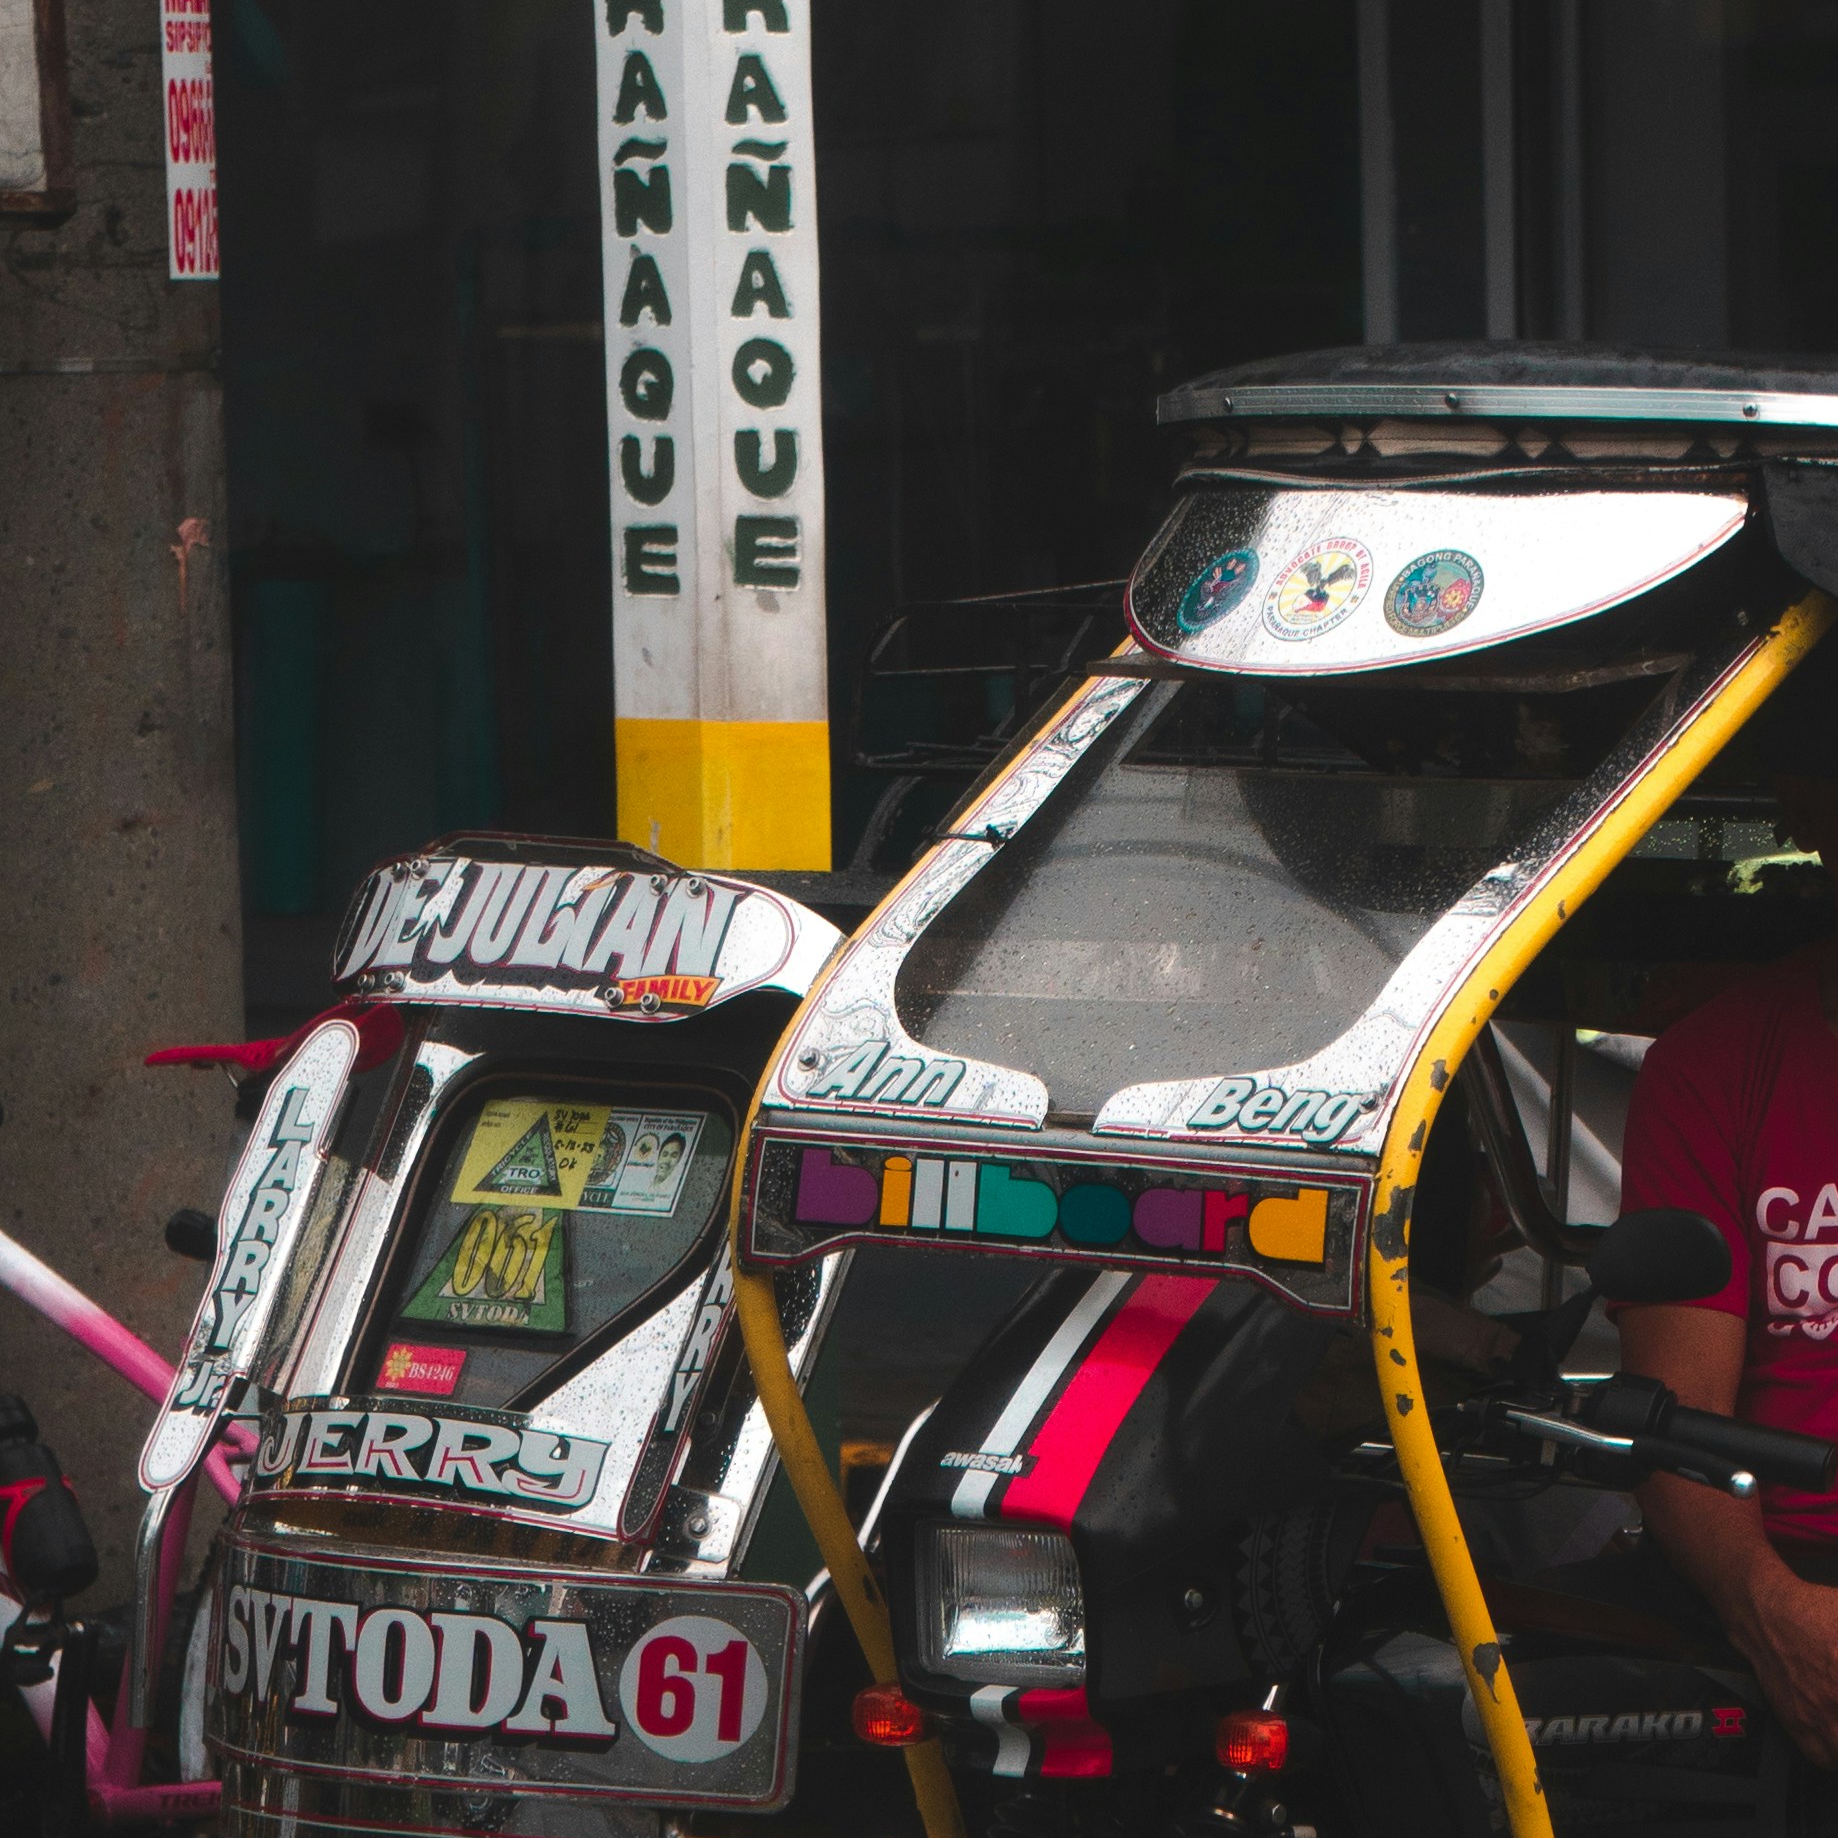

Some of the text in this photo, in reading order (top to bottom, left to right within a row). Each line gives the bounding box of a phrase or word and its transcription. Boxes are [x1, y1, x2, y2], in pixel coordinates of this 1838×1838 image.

[618, 976, 718, 1006] FAMILY
[806, 1039, 967, 1108] Ann
[1186, 1077, 1374, 1142] Beng
[500, 1185, 538, 1194] OFFICE
[508, 1167, 541, 1179] TRO
[794, 1148, 1330, 1264] billboard
[212, 1085, 316, 1352] LARRY
[451, 1209, 560, 1302] 061
[223, 1585, 619, 1742] SVTODA
[636, 1635, 749, 1743] 61
